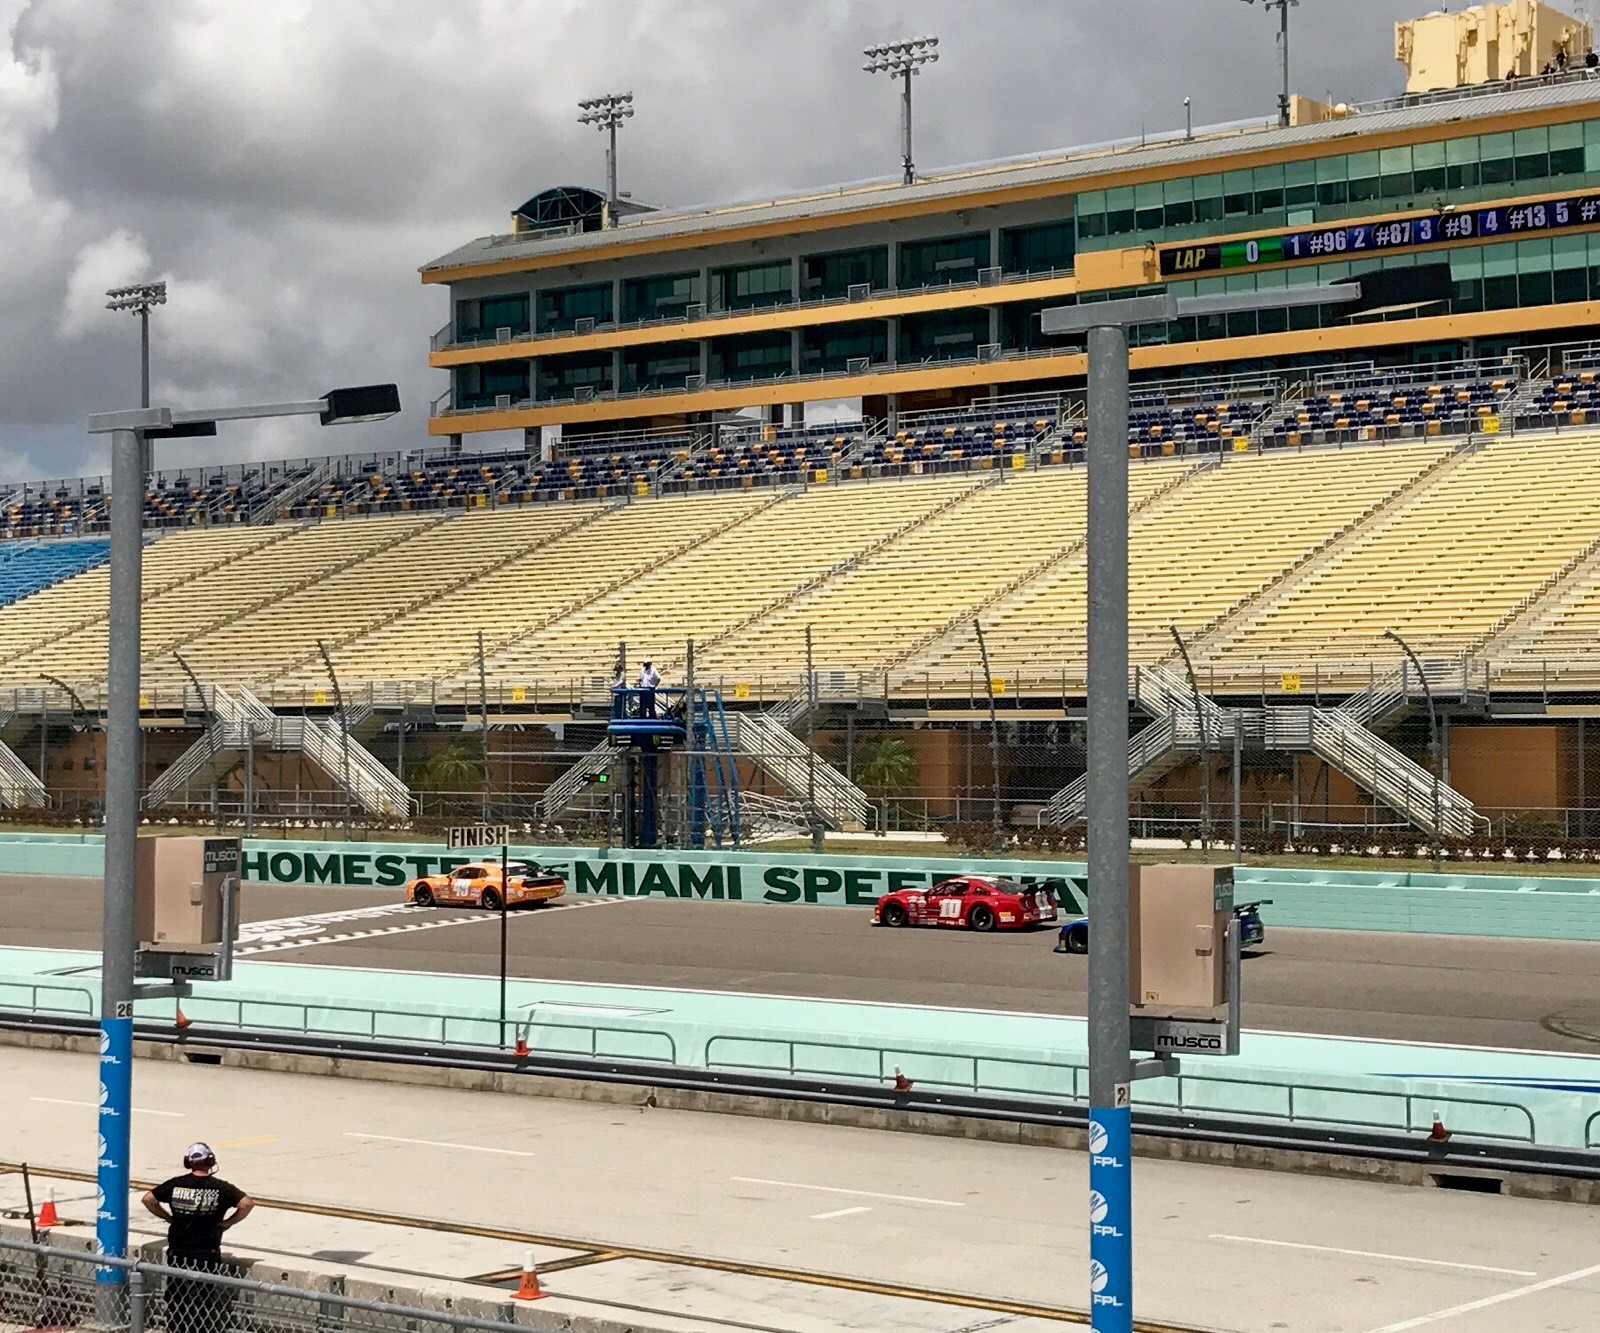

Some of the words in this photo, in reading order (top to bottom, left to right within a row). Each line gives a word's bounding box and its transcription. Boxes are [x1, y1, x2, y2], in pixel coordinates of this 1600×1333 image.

[1174, 248, 1206, 270] LAP
[1246, 240, 1259, 263] 0
[1290, 235, 1300, 256] 1
[1309, 230, 1347, 254] #96
[1354, 228, 1366, 248] 2
[1376, 222, 1411, 246] #87
[1420, 219, 1432, 240] 3
[1445, 214, 1473, 237] #9
[1485, 211, 1499, 231] 4
[1509, 205, 1546, 229] #13
[1556, 202, 1569, 223] 5
[451, 826, 507, 847] FINISH
[117, 1003, 132, 1018] 26
[1093, 1156, 1124, 1167] FPL
[172, 1187, 196, 1200] MIKE
[1093, 1225, 1124, 1237] FPL
[1093, 1295, 1124, 1306] FPL
